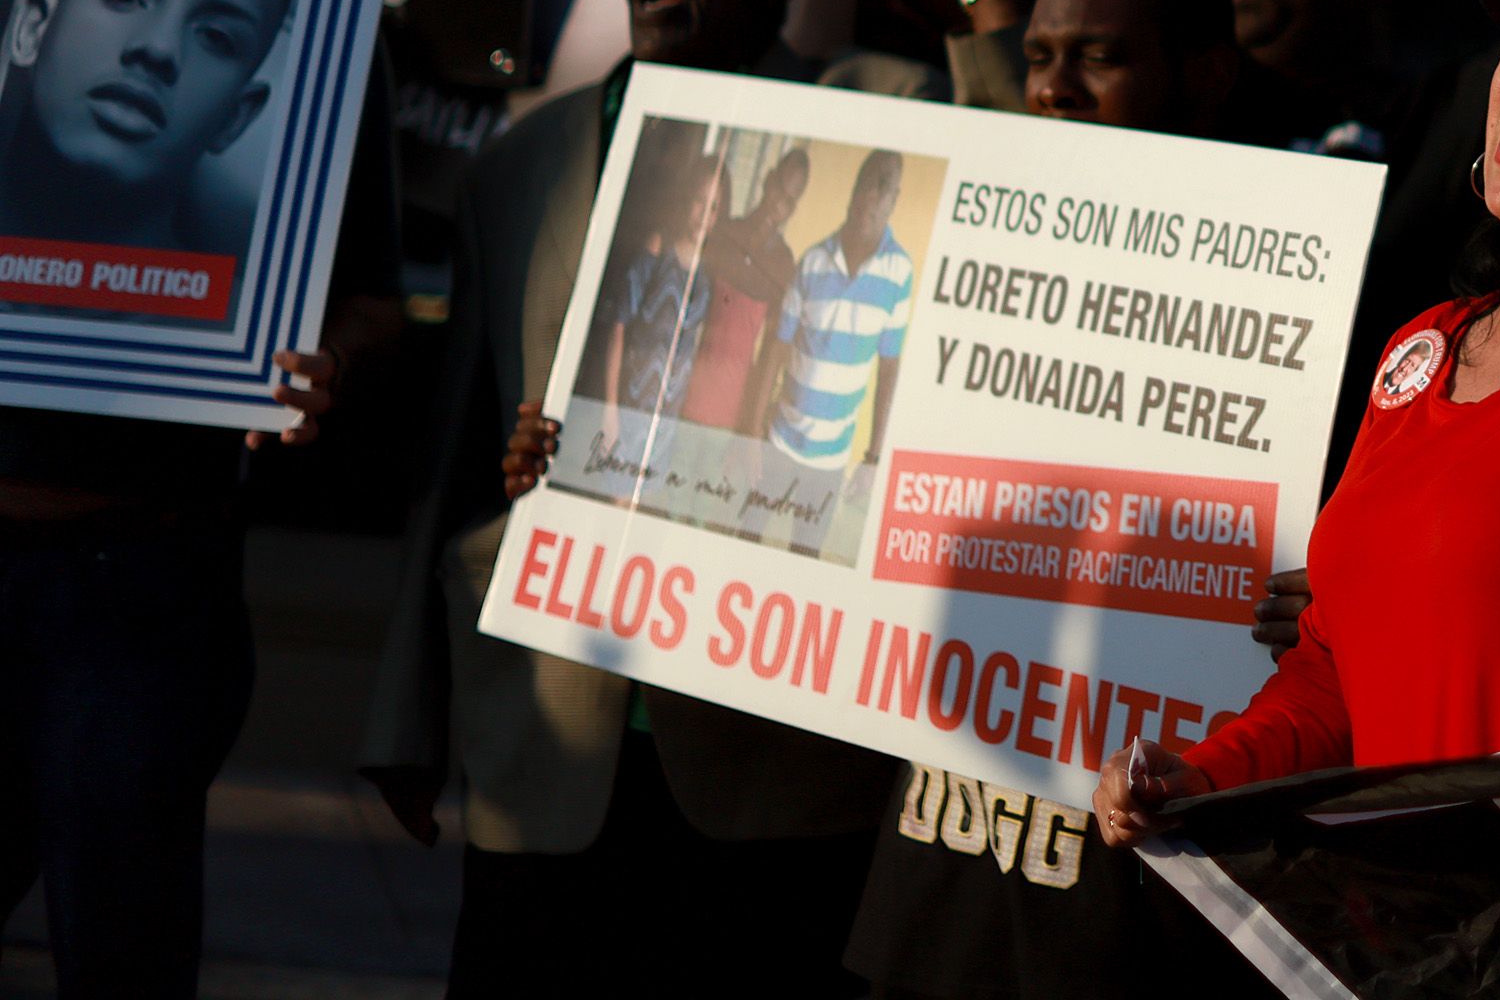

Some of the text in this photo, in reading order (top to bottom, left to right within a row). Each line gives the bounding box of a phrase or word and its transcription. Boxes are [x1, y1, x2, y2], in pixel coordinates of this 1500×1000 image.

[90, 261, 210, 300] POLITICO
[951, 181, 1331, 284] ESTOS SON MIS PADRES:
[933, 256, 1313, 371] LORETO HERNANDEZ
[936, 335, 1271, 453] Y DONAIDA PEREZ.
[894, 471, 1257, 548] ESTAN PRESOS EN CUBA
[513, 527, 695, 651] ELLOS
[707, 579, 844, 695] SON
[886, 528, 1254, 601] POR PROTESTAR PACIFICAMENTE
